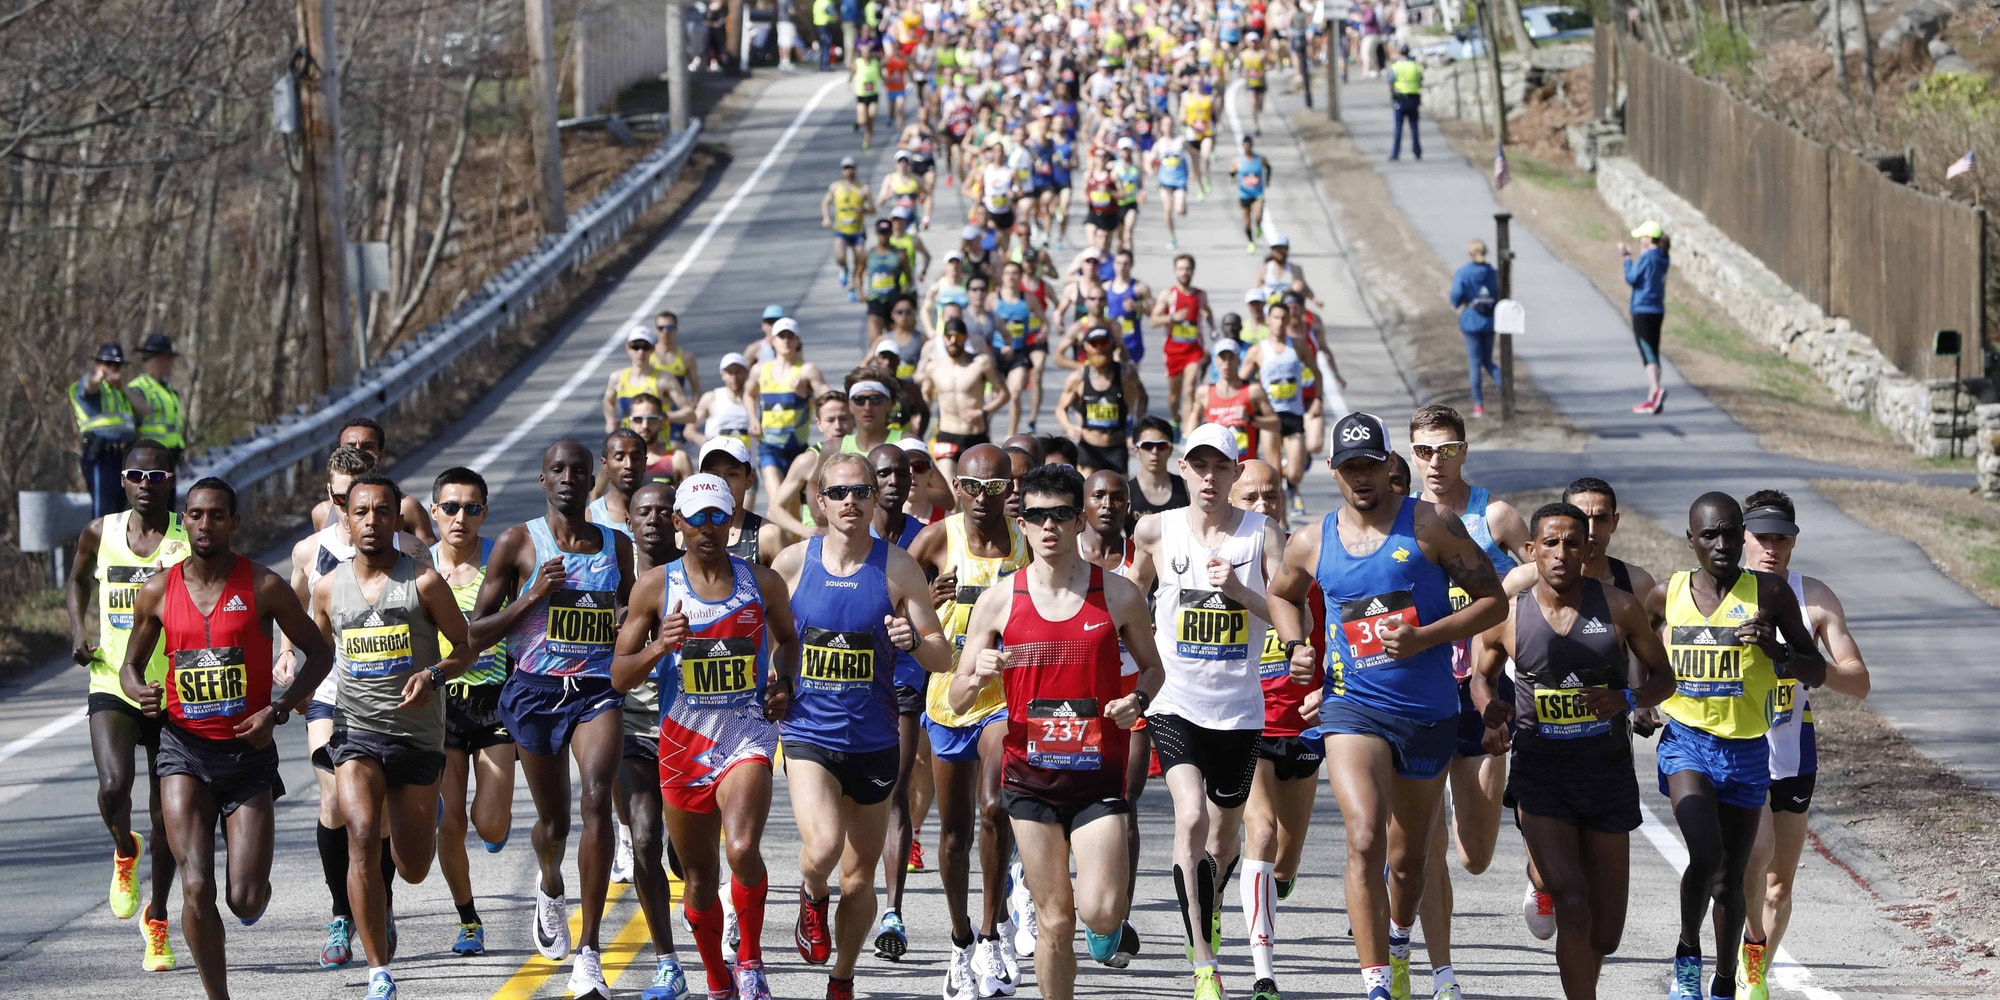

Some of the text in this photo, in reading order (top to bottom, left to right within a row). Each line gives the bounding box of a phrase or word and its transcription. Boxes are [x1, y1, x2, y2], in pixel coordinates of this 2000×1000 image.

[1342, 426, 1371, 442] SOS
[692, 483, 719, 492] NYAC
[825, 580, 859, 589] saucony
[109, 589, 140, 608] BIW
[223, 604, 248, 612] adidas
[1365, 606, 1389, 617] adidas
[363, 620, 384, 628] adidas
[551, 609, 614, 642] KORIR
[1183, 610, 1244, 644] RUPP
[1582, 627, 1608, 635] adidas
[346, 632, 410, 655] ASMEROM
[197, 659, 221, 667] adidas
[806, 648, 871, 679] WARD
[1672, 649, 1740, 678] MUTAI
[180, 667, 243, 702] SEFIR
[694, 658, 747, 692] MEB
[1537, 693, 1594, 719] TSEG
[1775, 684, 1795, 706] EY
[1042, 720, 1089, 742] 237
